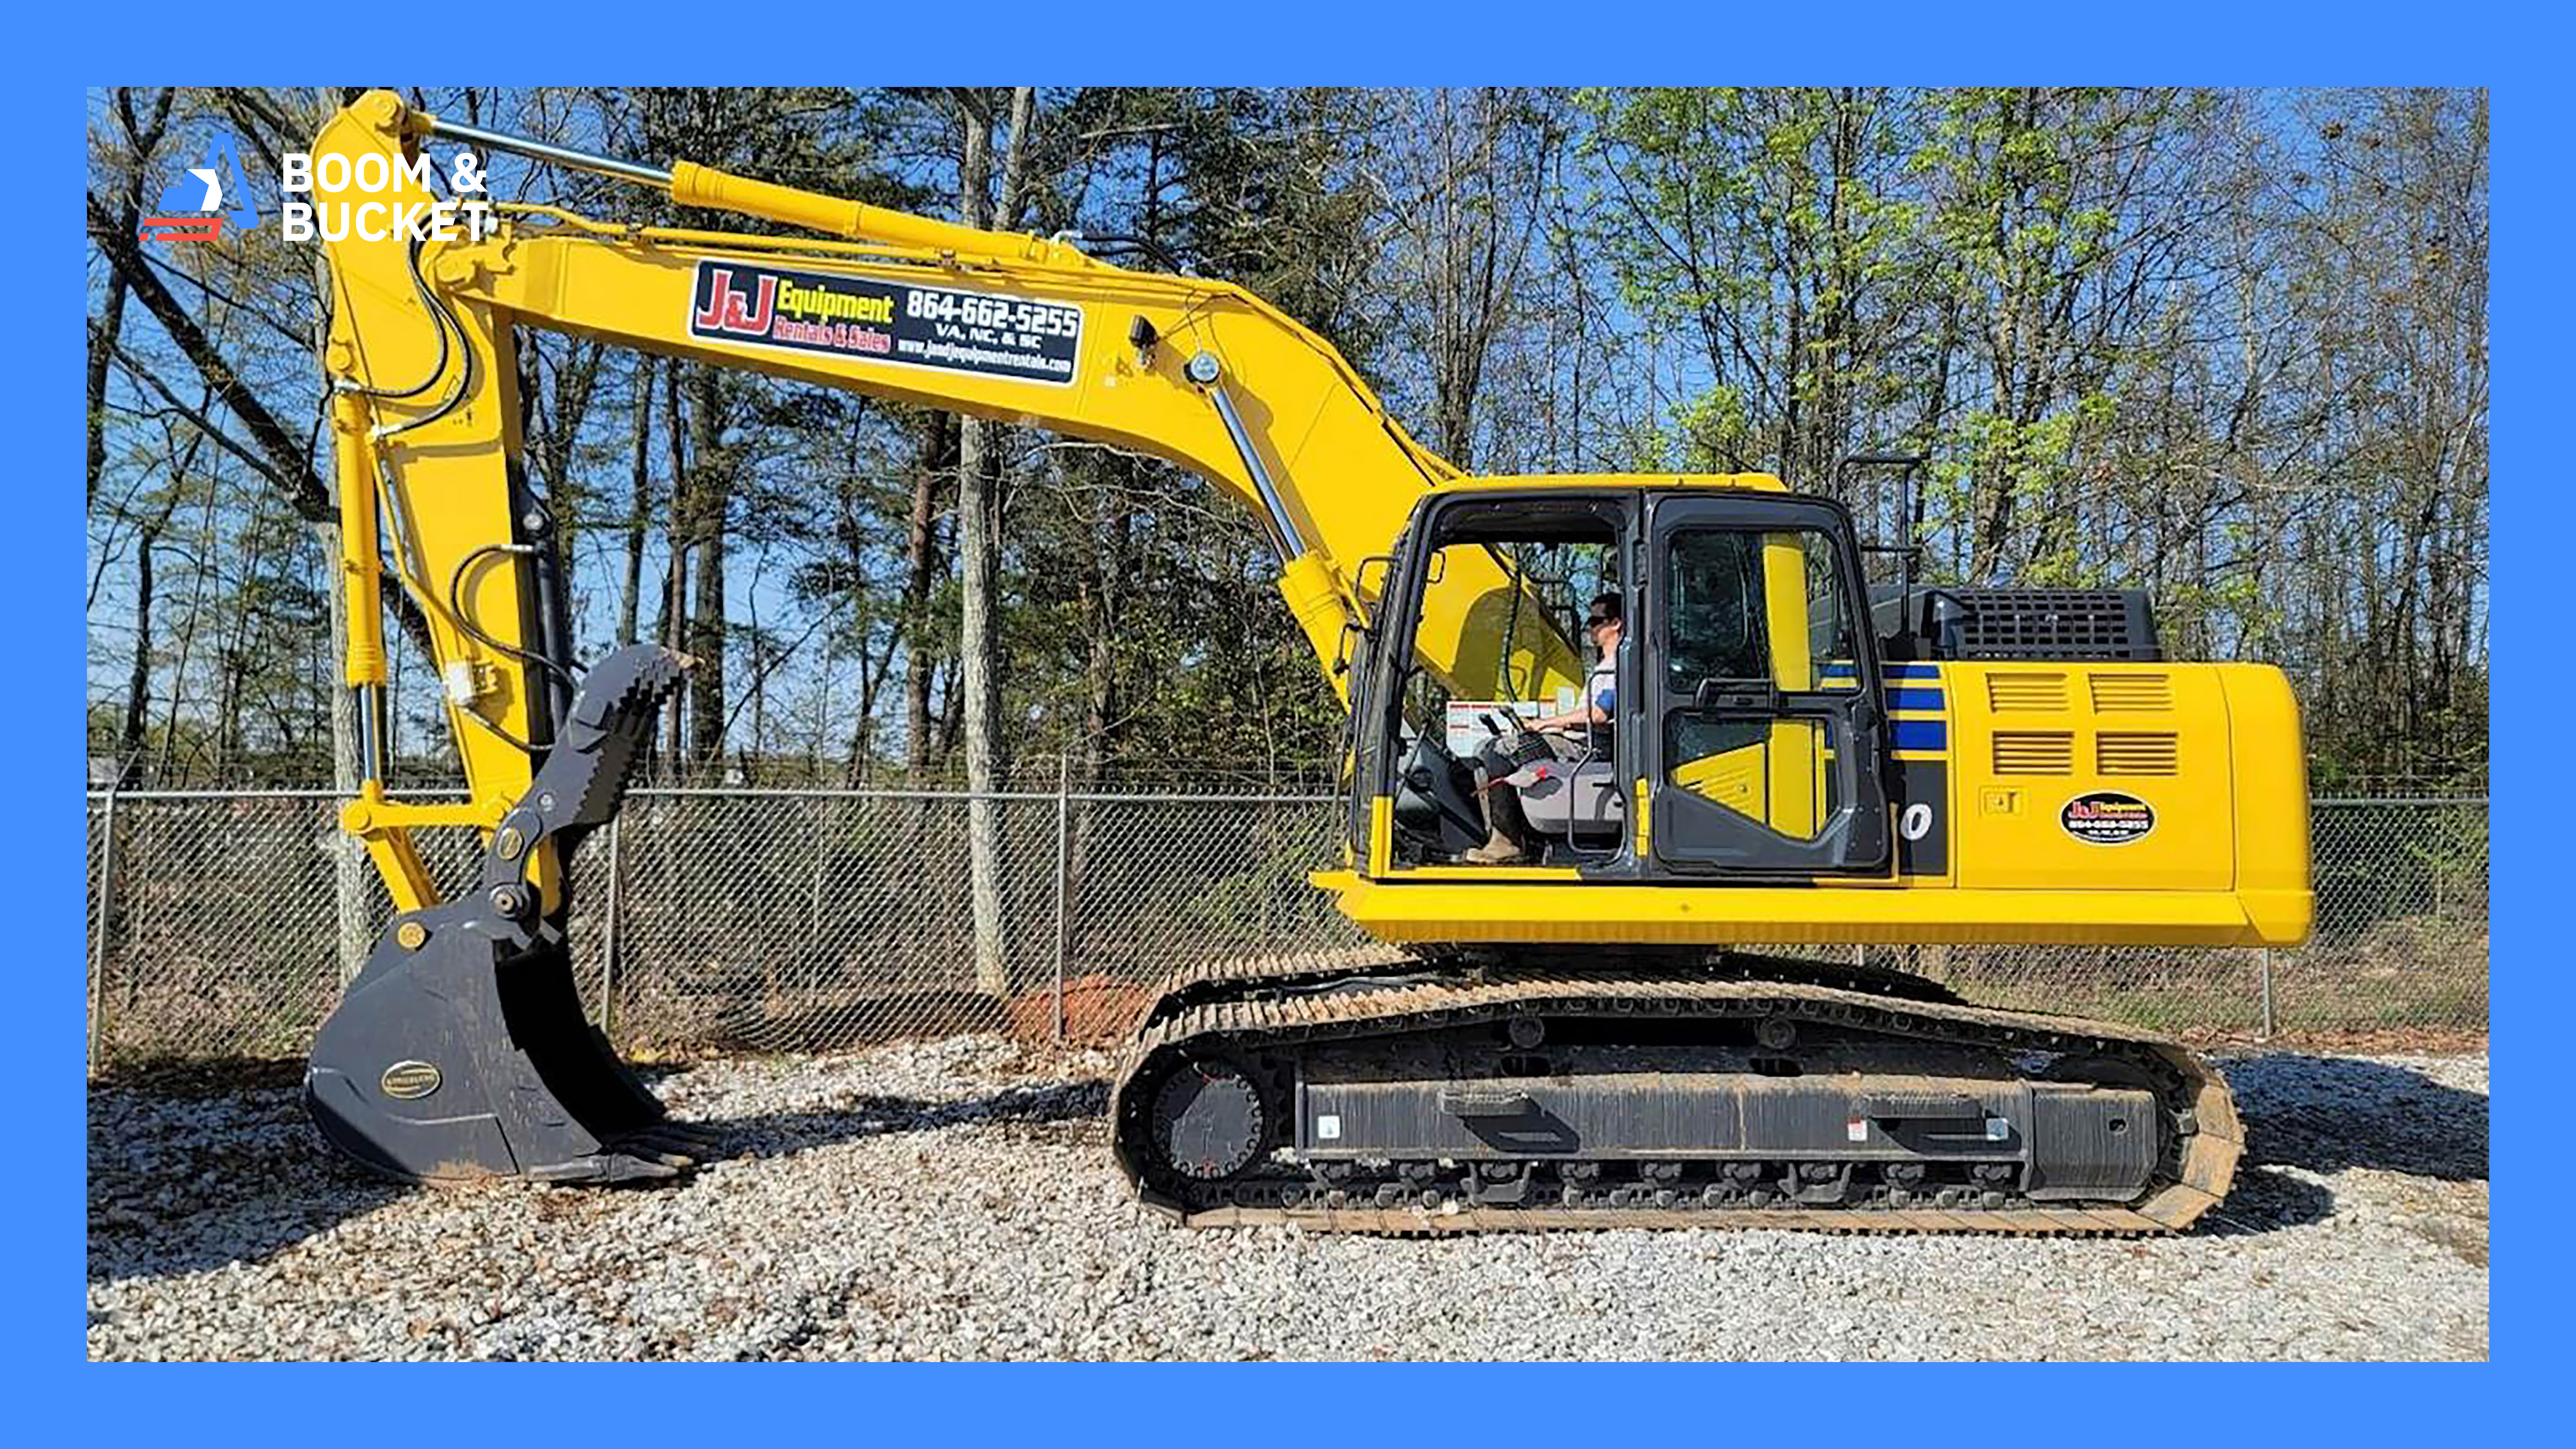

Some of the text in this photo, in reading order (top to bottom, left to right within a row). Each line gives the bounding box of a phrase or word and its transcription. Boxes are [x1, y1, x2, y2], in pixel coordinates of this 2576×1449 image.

[696, 269, 895, 336] J&J Equipment
[907, 290, 1079, 337] 864-662-5255
[773, 315, 891, 353] Rentals & Sales
